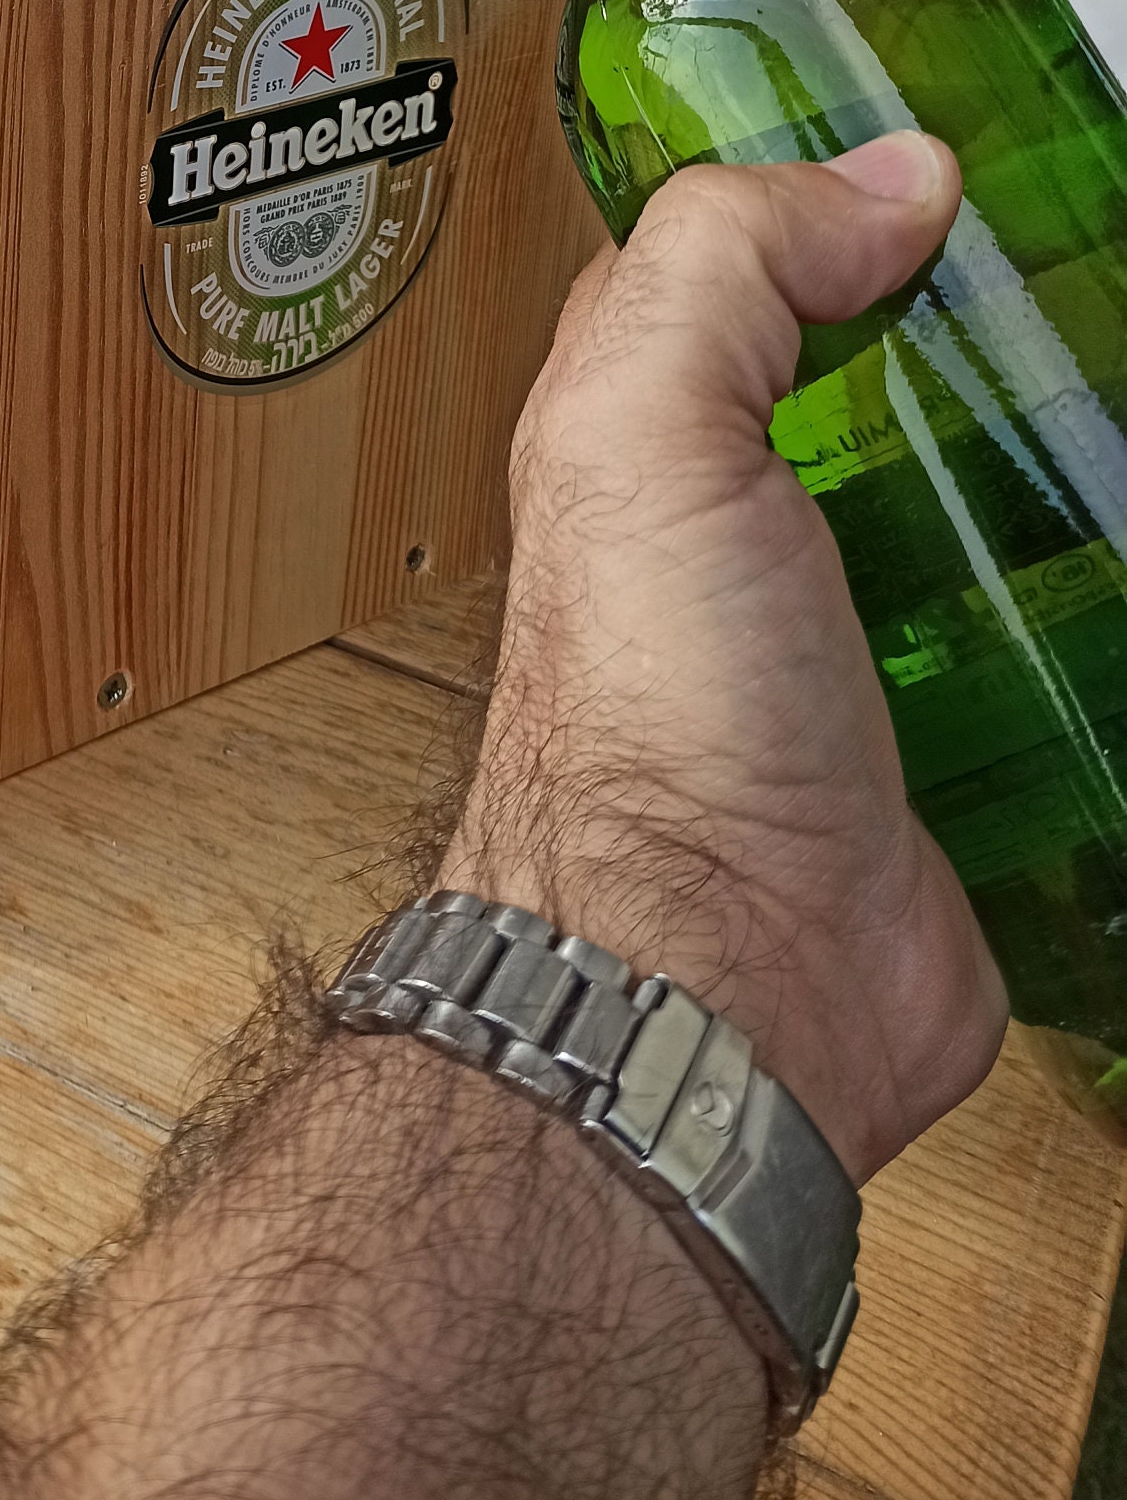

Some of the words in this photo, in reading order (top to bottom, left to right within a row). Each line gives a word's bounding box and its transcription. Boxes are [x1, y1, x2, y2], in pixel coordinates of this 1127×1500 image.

[250, 52, 265, 102] DIPLOME
[266, 78, 286, 93] EST.
[340, 60, 361, 73] 1873
[168, 90, 438, 206] Heineken
[256, 196, 291, 214] MEDAILLE
[293, 190, 311, 205] D'OR
[313, 184, 334, 200] PARIS
[336, 178, 352, 192] 1875
[355, 174, 365, 199] 1900
[242, 207, 251, 235] HORS
[260, 208, 285, 224] GRAND
[288, 204, 305, 219] PRIX
[307, 196, 328, 212] PARIS
[348, 204, 362, 237] PARIS
[185, 237, 213, 254] TRADE
[328, 241, 348, 264] JURY
[242, 240, 270, 283] CONCOURS
[272, 269, 308, 284] MEMBRE
[313, 262, 325, 274] DU
[190, 271, 251, 341] PURE
[253, 295, 325, 344] MALT
[334, 218, 404, 311] LAGER
[353, 303, 374, 328] 500
[271, 331, 318, 374] בירה
